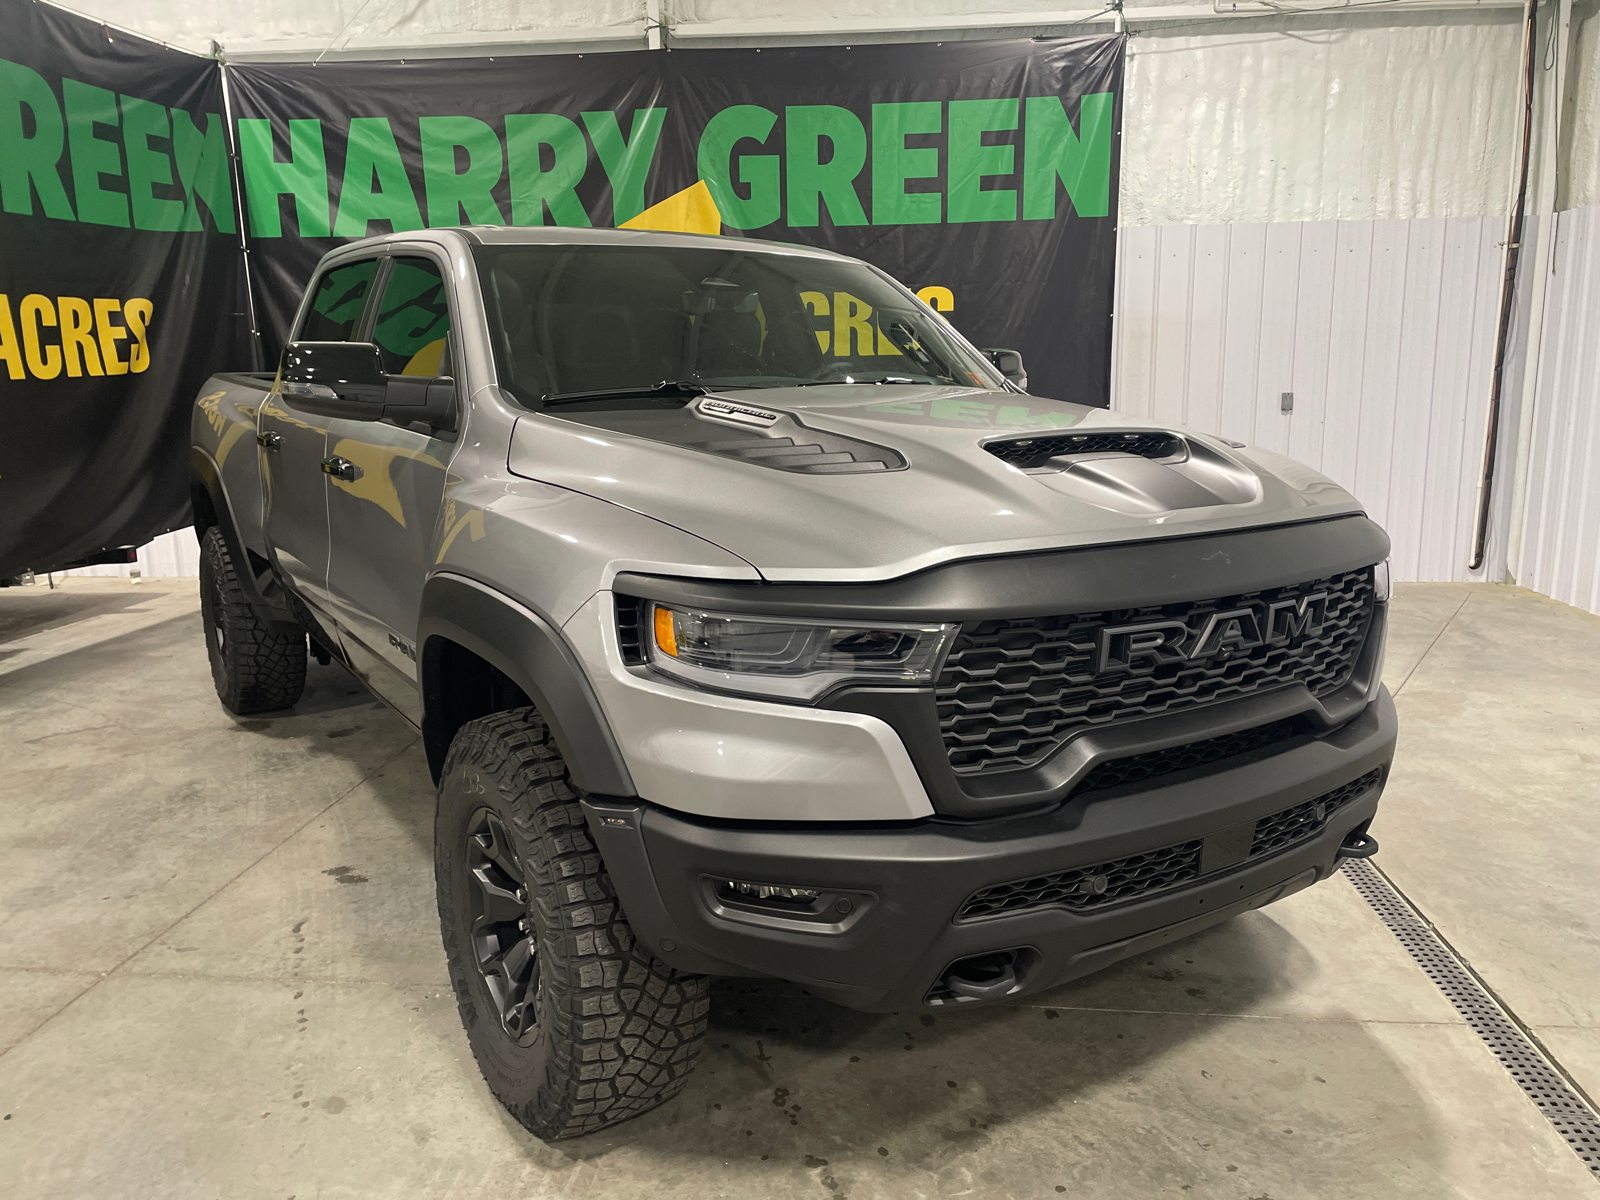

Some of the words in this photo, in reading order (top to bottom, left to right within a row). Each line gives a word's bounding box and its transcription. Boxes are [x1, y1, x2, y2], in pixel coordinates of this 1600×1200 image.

[238, 107, 668, 238] HARRY
[696, 92, 1114, 231] GREEN
[1098, 591, 1328, 673] RAM
